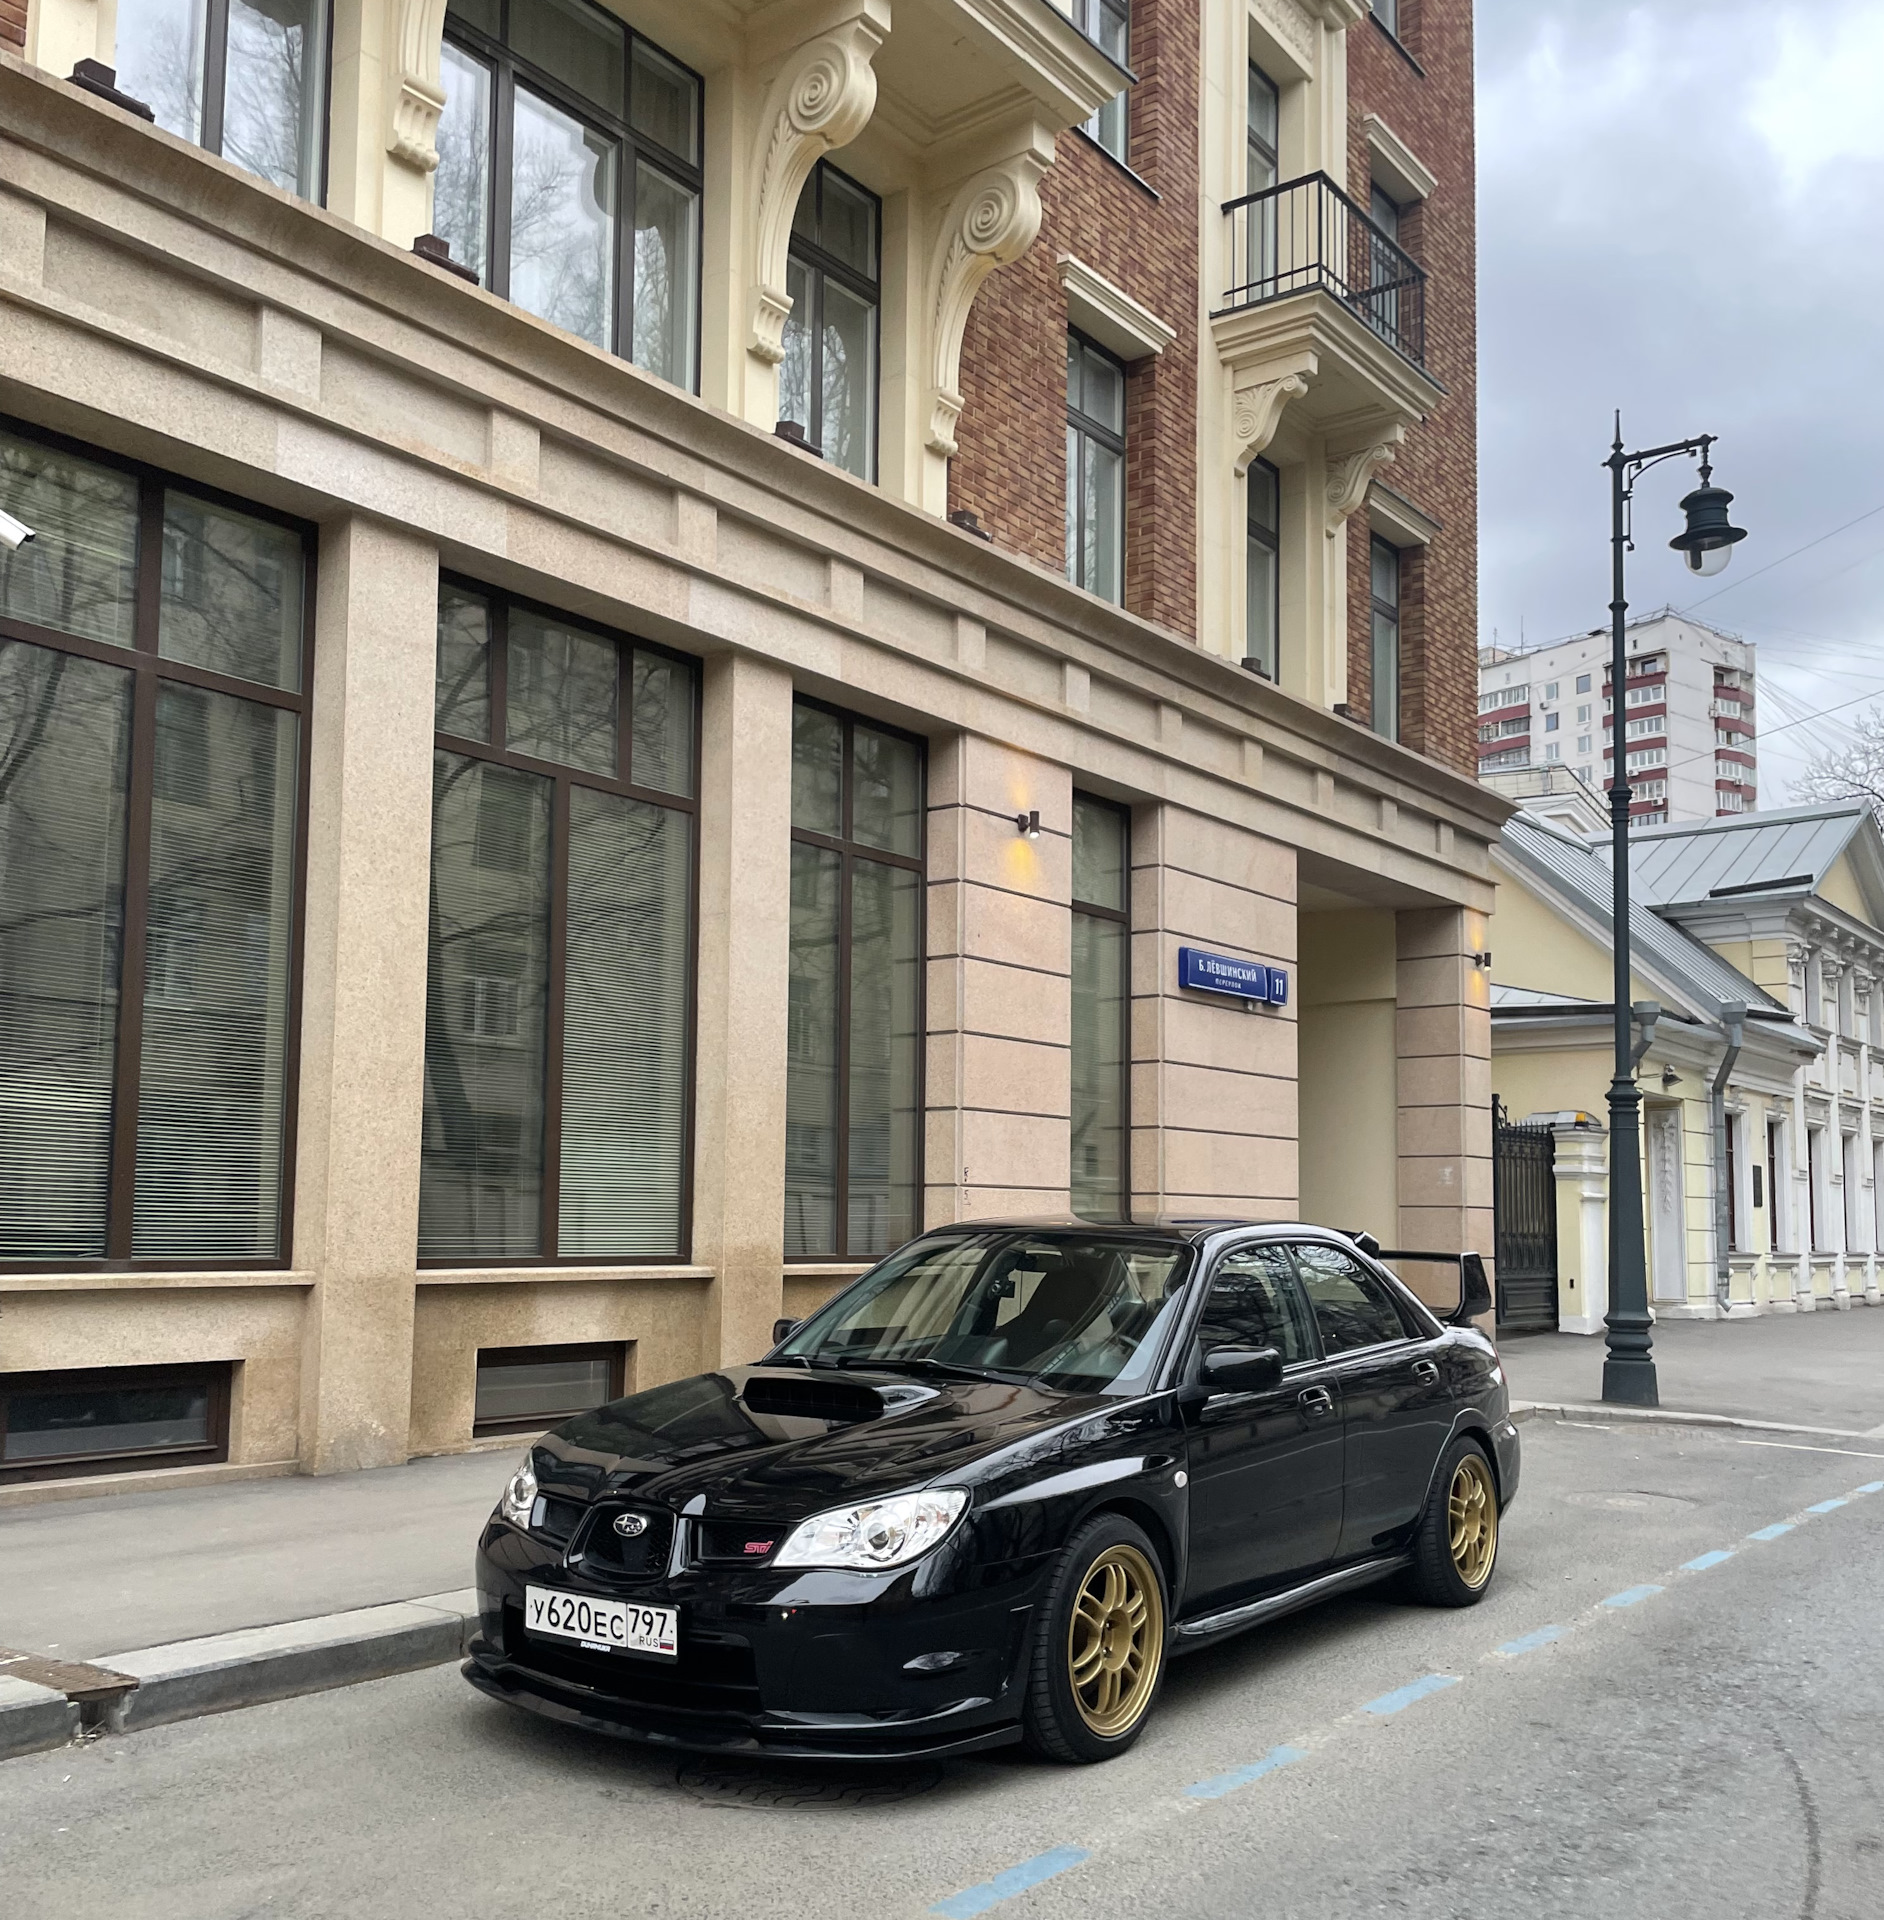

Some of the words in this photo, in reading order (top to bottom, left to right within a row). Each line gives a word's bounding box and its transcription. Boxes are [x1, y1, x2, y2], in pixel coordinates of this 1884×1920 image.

[1198, 959, 1206, 972] Б.
[1206, 960, 1257, 982] ЛЁВШИНСКИЙ
[1275, 978, 1283, 996] 11
[639, 1635, 659, 1648] RUS
